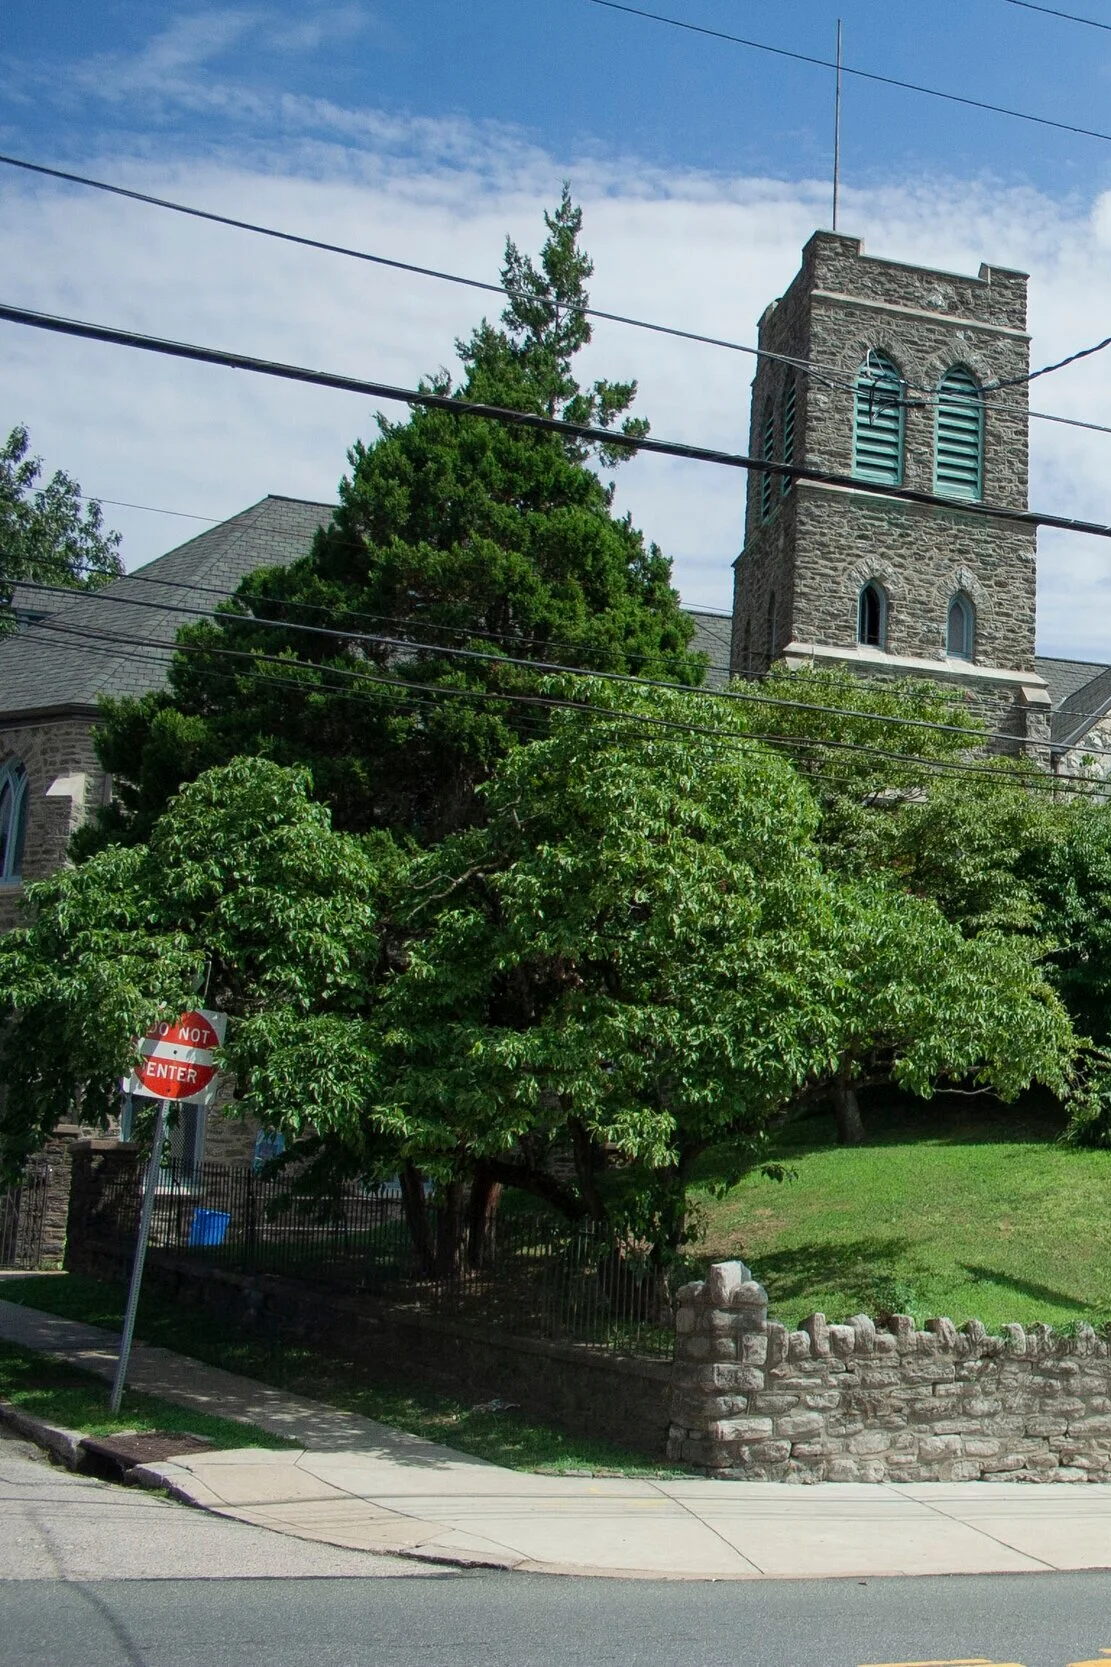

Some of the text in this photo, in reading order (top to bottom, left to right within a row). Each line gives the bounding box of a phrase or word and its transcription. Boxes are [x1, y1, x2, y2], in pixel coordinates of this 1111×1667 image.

[146, 1021, 210, 1044] DO NOT
[146, 1060, 198, 1084] ENTER
